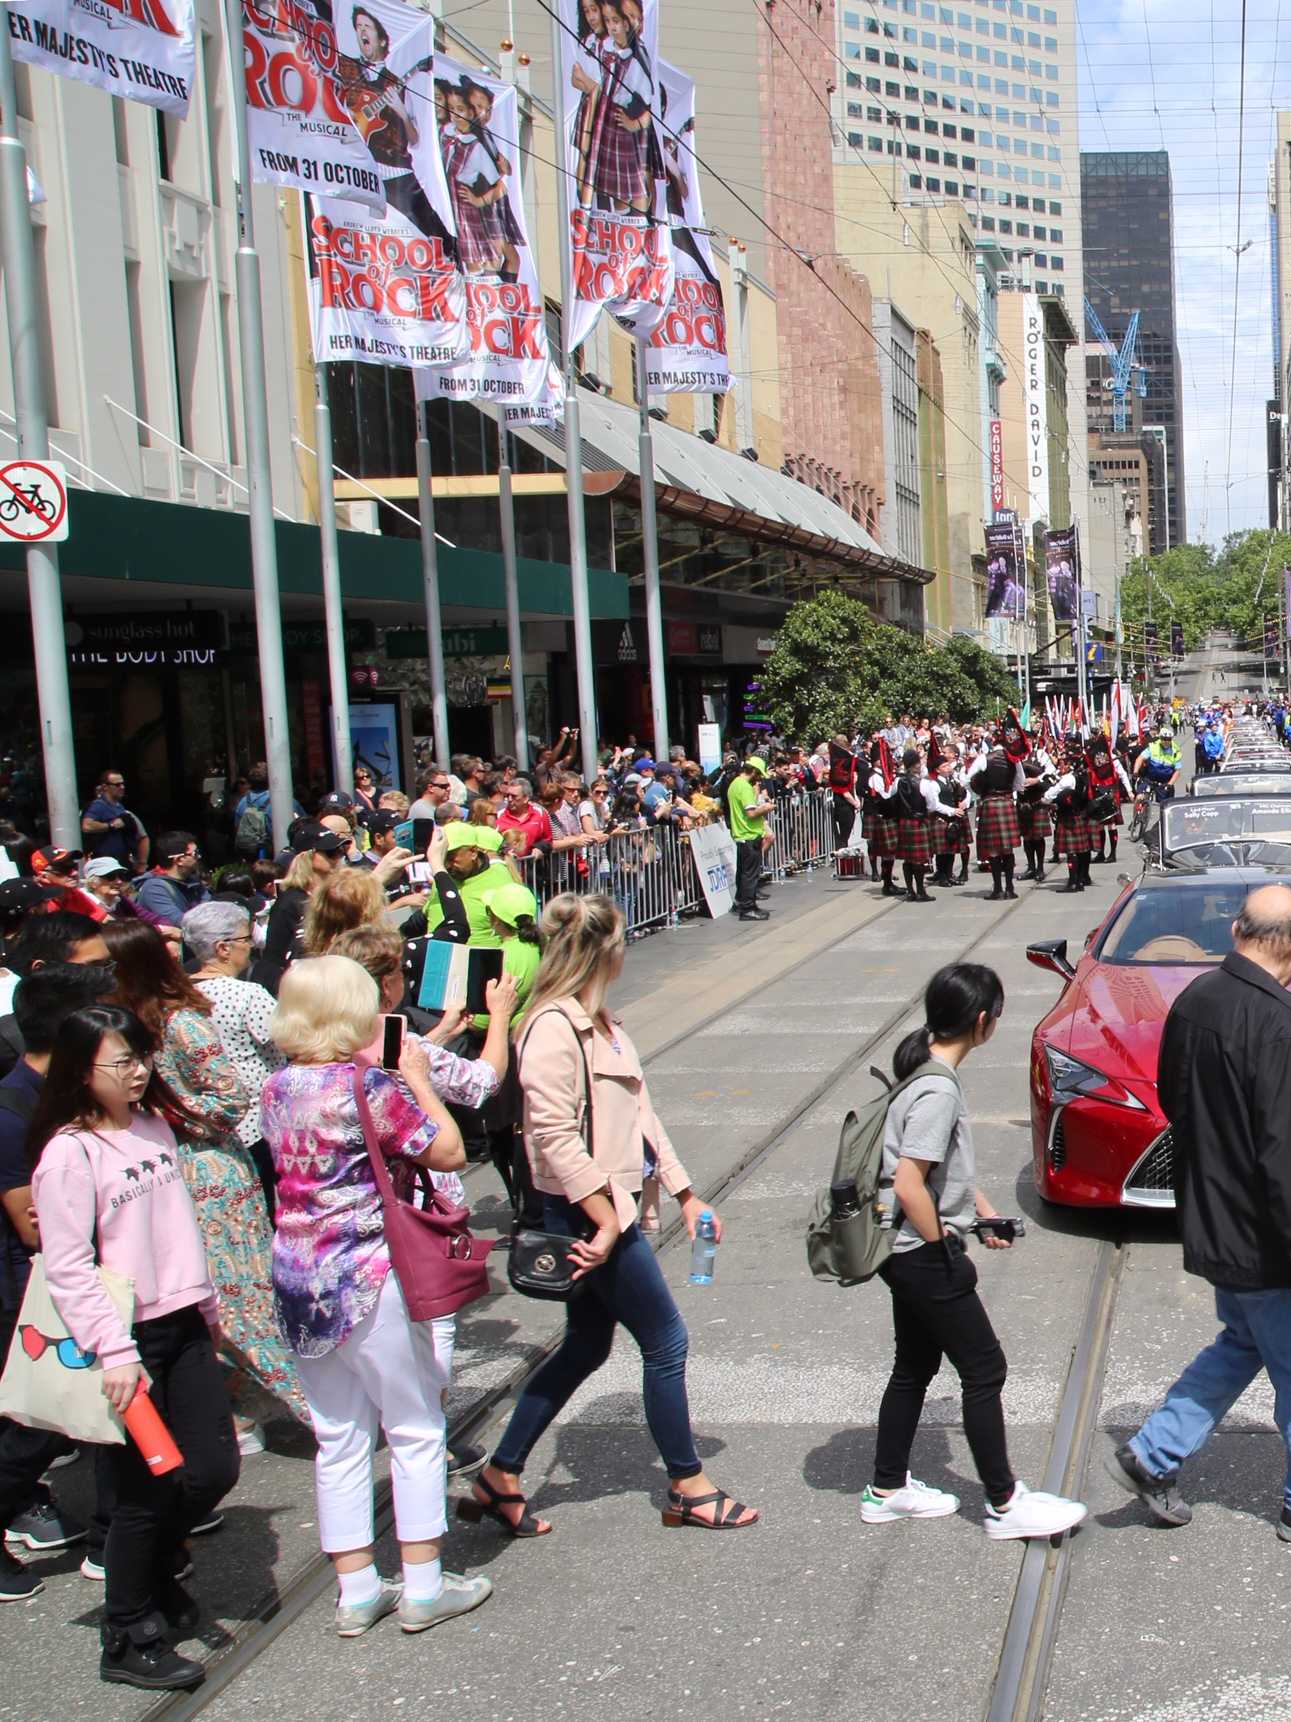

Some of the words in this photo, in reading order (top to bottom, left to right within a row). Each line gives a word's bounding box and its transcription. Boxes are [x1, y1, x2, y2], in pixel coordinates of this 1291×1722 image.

[8, 12, 34, 43] ER
[33, 20, 120, 79] MAJESTY'S
[119, 58, 188, 100] THEATRE
[300, 122, 348, 137] MUSICAL
[259, 148, 300, 177] FROM
[303, 158, 319, 181] 31
[323, 162, 380, 194] OCTOBER
[312, 215, 456, 273] SCHOOL
[317, 257, 460, 323] ROCK
[330, 334, 354, 350] HER
[354, 336, 407, 359] MAJESTY'S
[409, 346, 457, 361] THEATRE
[1027, 316, 1041, 391] ROGER
[439, 376, 468, 393] FROM
[470, 379, 481, 392] 31
[483, 380, 525, 395] OCTOBER
[662, 371, 716, 386] MAJESTY'S
[991, 423, 1002, 504] CAUSEWAY
[1029, 403, 1043, 478] DAVID
